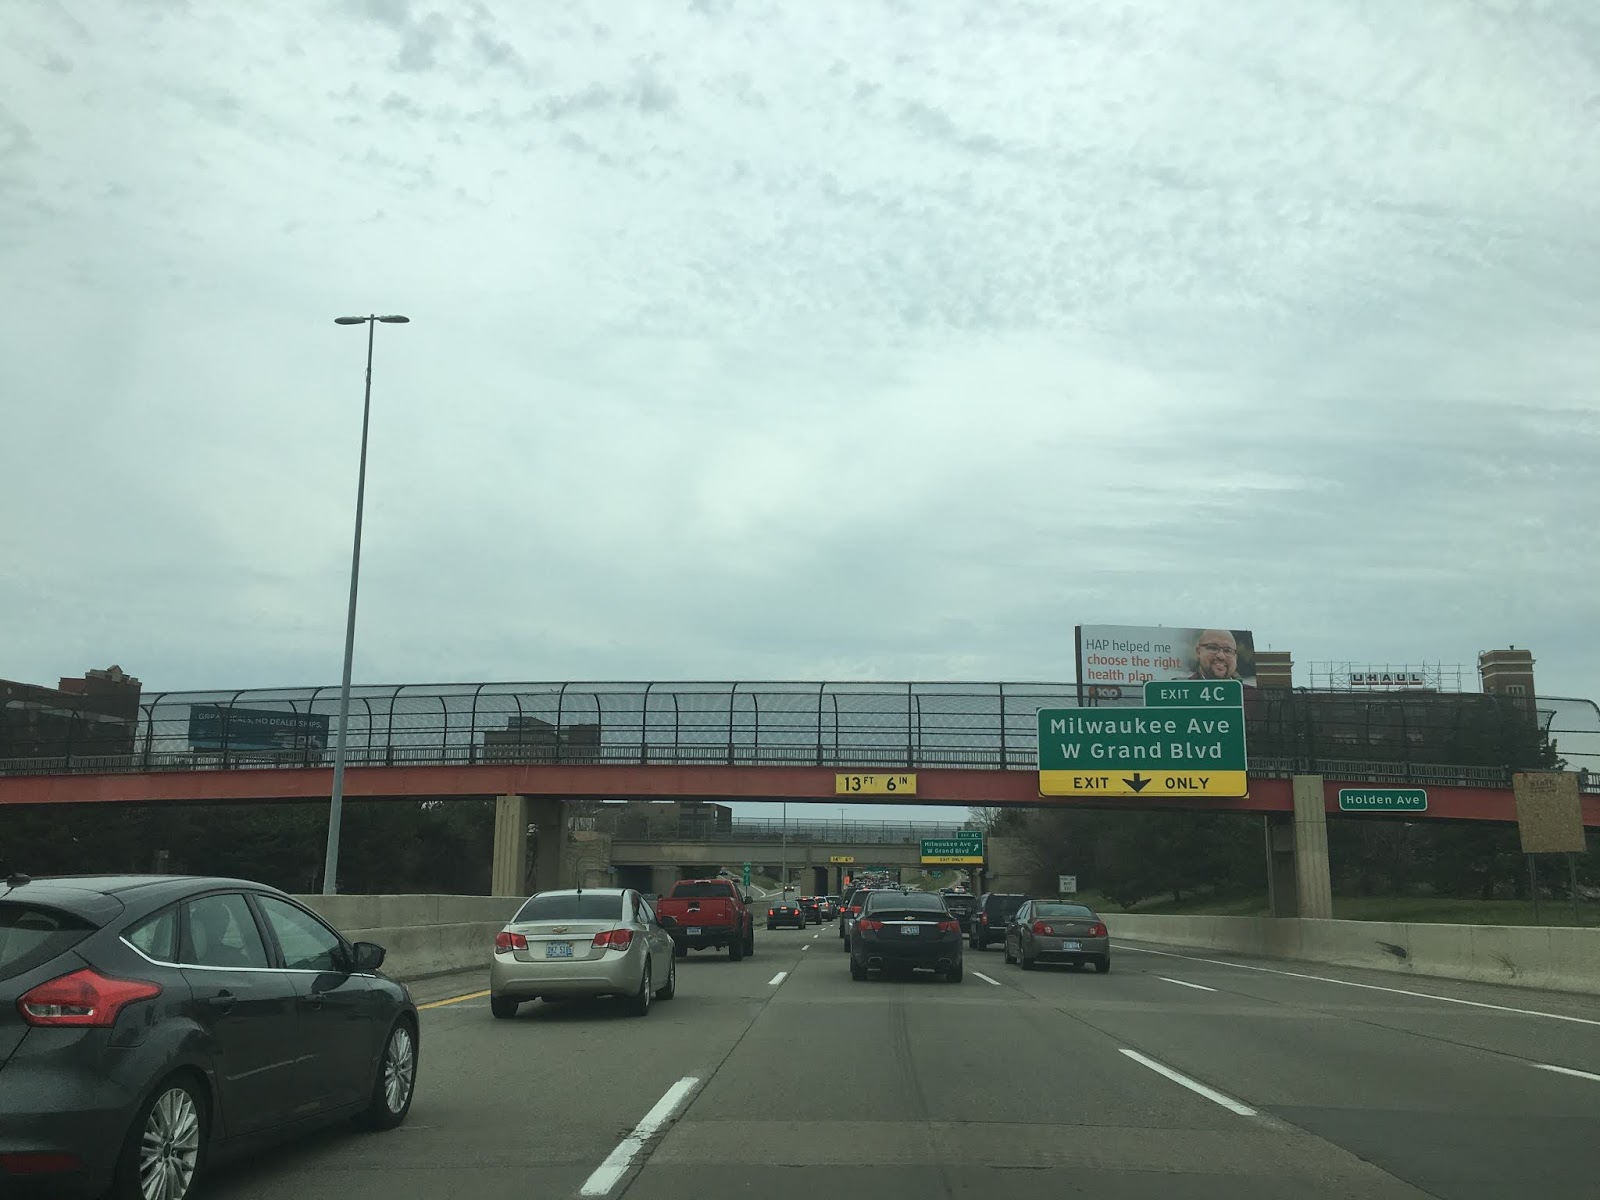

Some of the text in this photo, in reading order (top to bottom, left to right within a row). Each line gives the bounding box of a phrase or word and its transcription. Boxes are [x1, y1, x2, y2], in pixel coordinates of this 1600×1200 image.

[1086, 639, 1171, 654] HAP helped me
[1087, 654, 1182, 670] choose the right
[1088, 669, 1125, 681] health
[1160, 686, 1225, 702] EXIT 4C
[256, 716, 268, 725] NO
[1050, 718, 1230, 734] Milwaukee Ave
[1061, 742, 1222, 759] W Grand Blvd
[845, 776, 908, 791] 13 FT 6 IN
[1073, 777, 1210, 789] EXIT ONLY
[1346, 794, 1420, 804] Holden Ave
